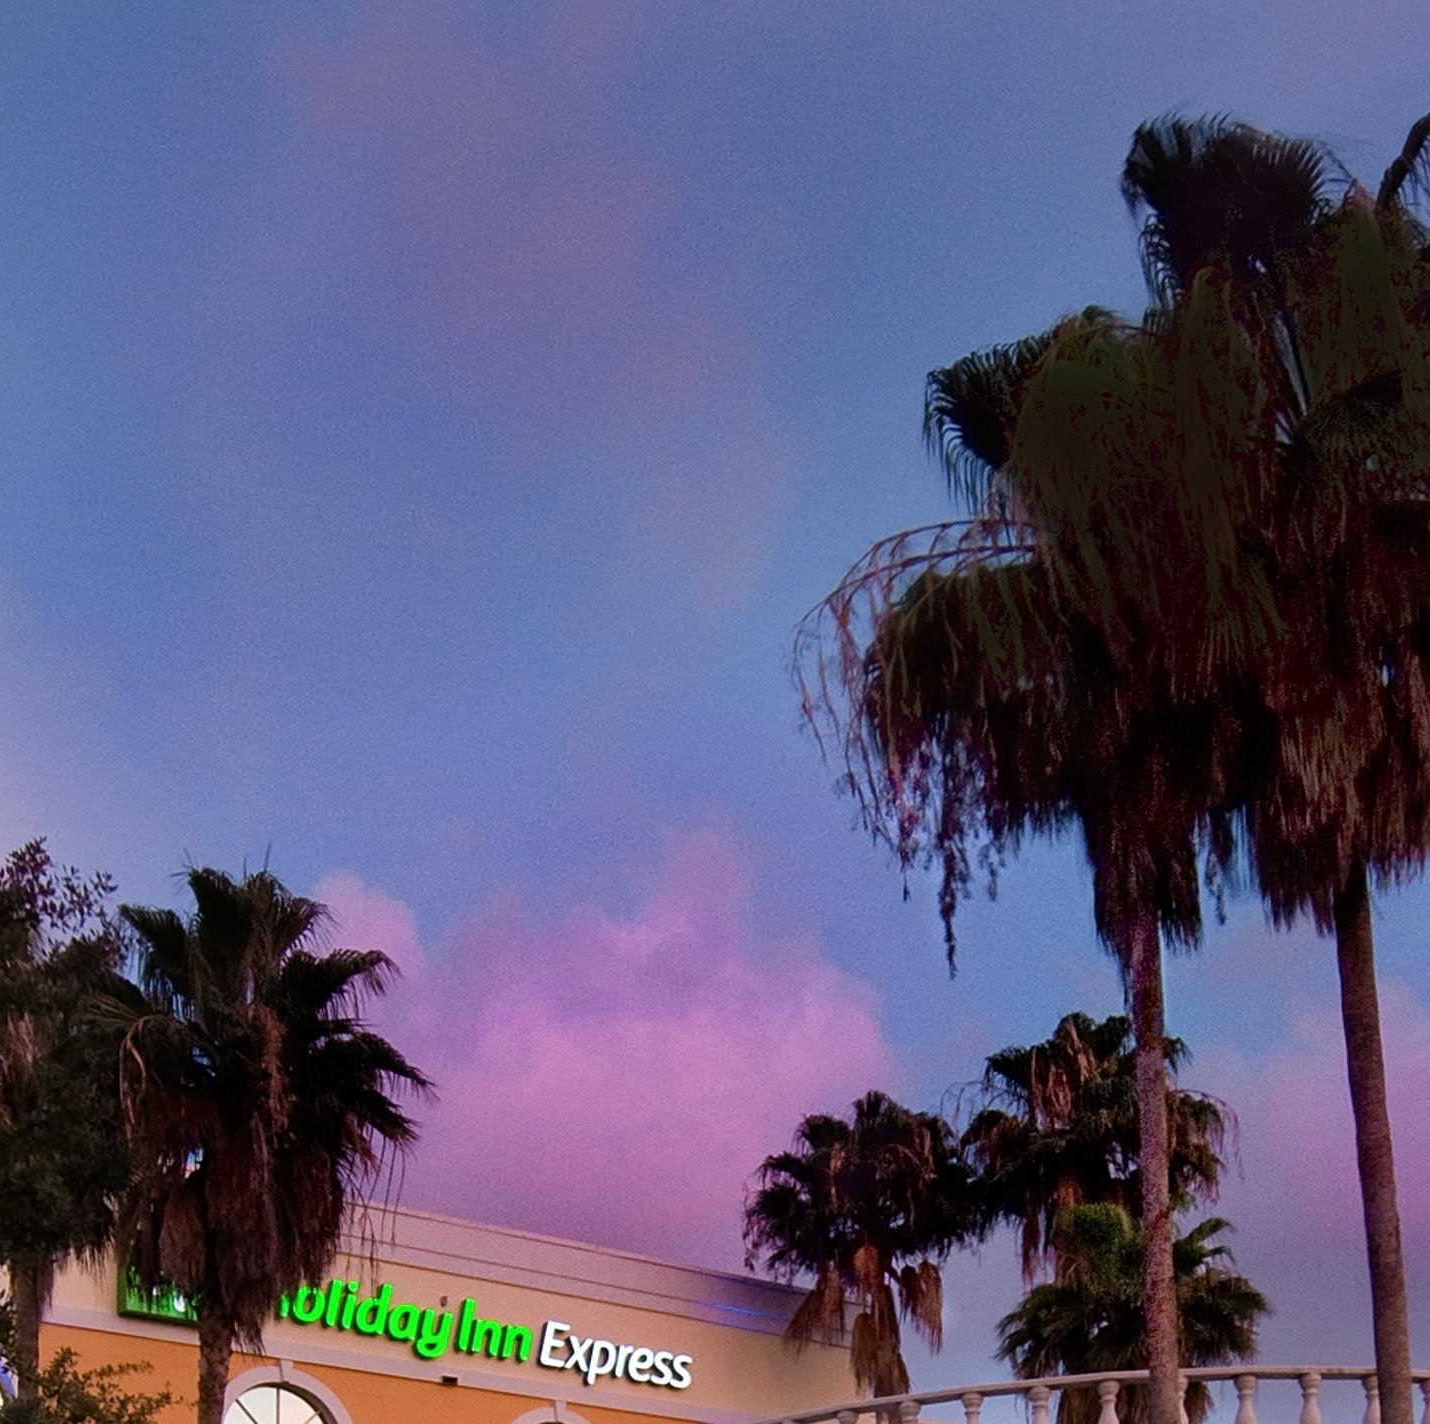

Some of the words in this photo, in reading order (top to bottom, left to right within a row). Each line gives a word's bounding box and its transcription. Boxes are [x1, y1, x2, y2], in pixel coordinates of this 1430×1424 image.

[279, 1278, 454, 1360] oliday
[458, 1297, 533, 1362] Inn
[539, 1320, 694, 1390] Express
